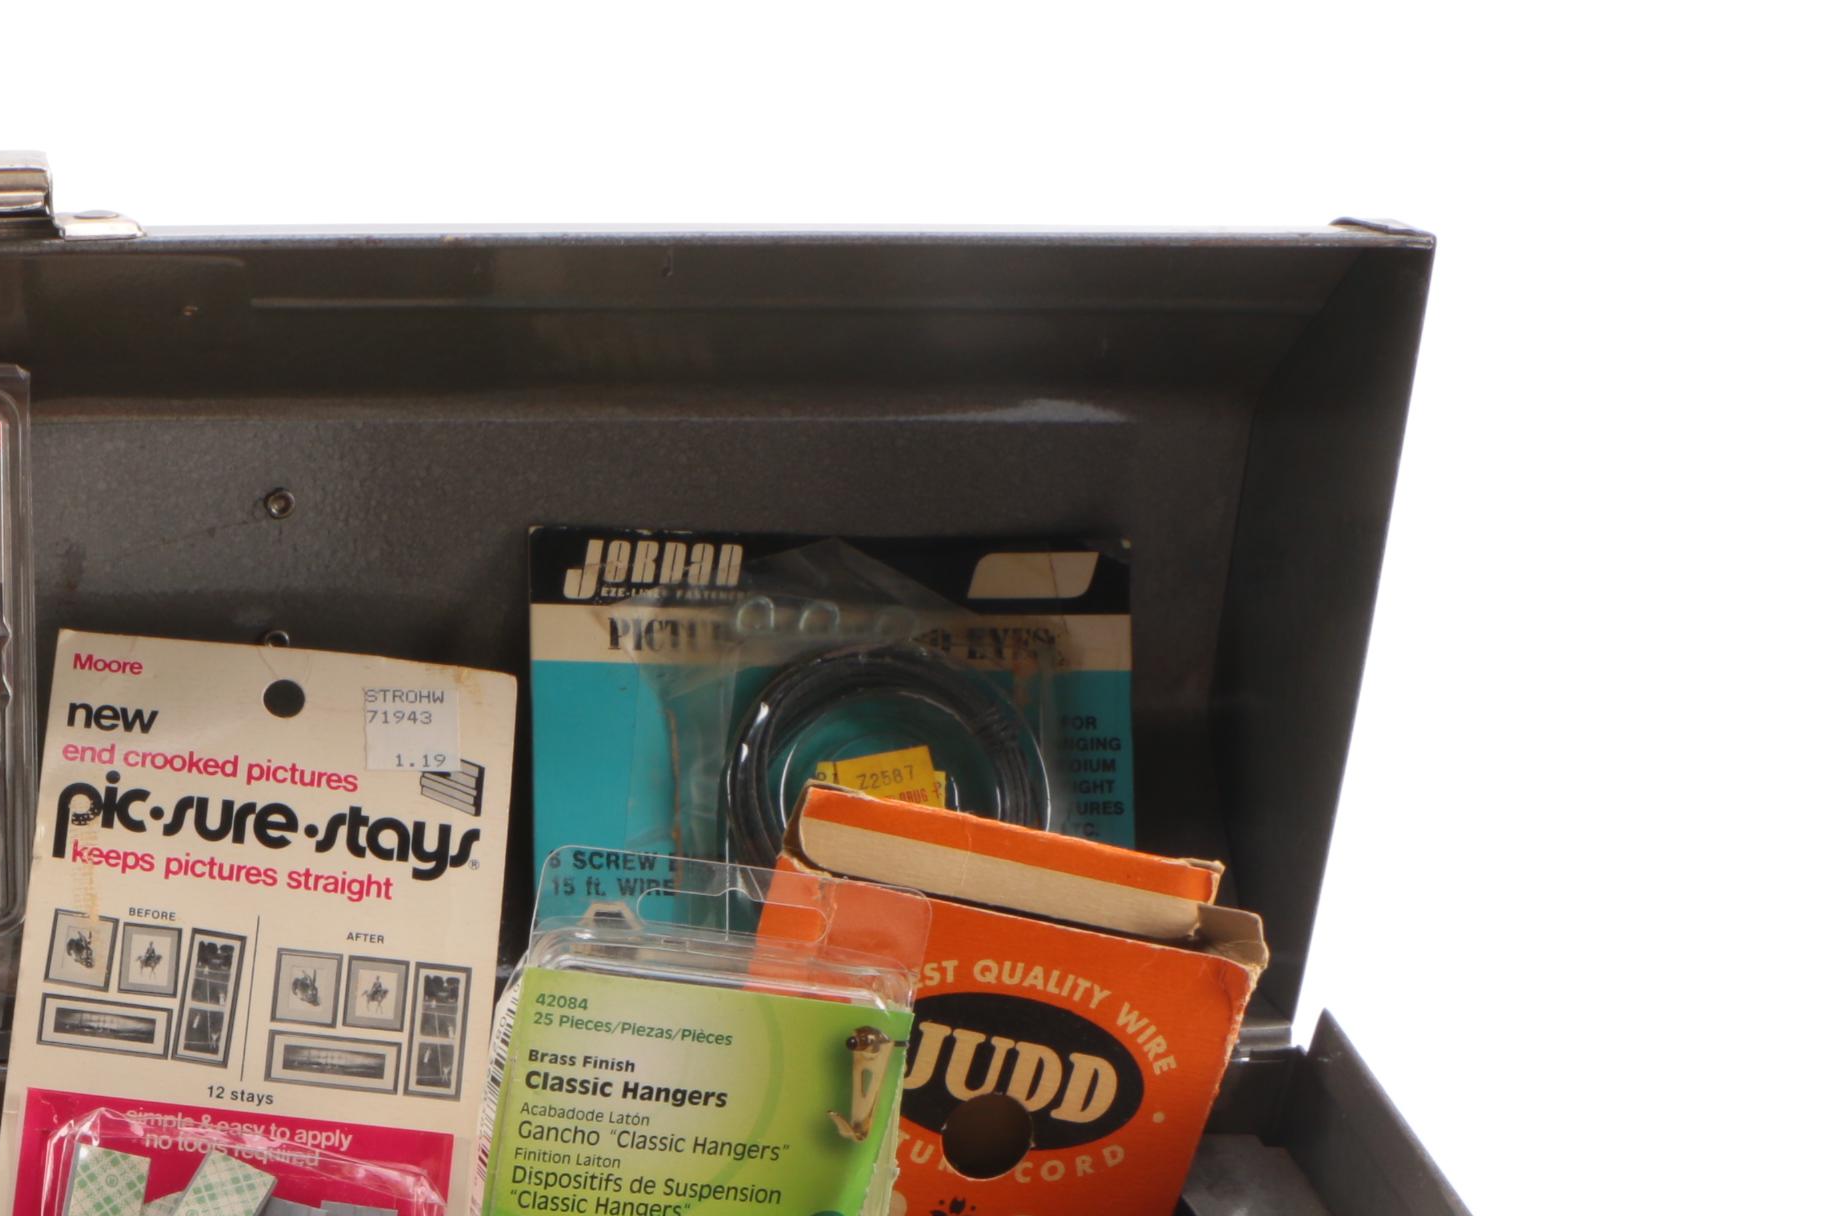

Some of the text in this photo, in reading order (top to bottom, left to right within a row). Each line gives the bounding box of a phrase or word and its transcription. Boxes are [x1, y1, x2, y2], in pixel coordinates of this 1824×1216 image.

[73, 653, 143, 675] Moore
[365, 688, 445, 705] STROHW
[67, 701, 159, 734] new
[366, 709, 433, 726] 71943
[62, 743, 358, 793] end crooked pictures
[395, 753, 447, 769] 1.19
[71, 839, 393, 901] keeps pictures straight
[573, 850, 657, 871] SCREW
[552, 877, 575, 896] 15
[617, 877, 675, 896] WIRE
[129, 907, 176, 921] BEFORE
[346, 931, 385, 945] AFTER
[536, 993, 589, 1010] 42084
[534, 1012, 554, 1026] 25
[974, 959, 1111, 1010] QUALITY
[1116, 1003, 1177, 1075] WIRE
[529, 1049, 636, 1073] Brass Finish
[904, 1021, 1117, 1123] JUDD
[207, 1085, 274, 1106] 12 stays
[525, 1071, 728, 1108] Classic Hangers
[126, 1108, 352, 1151] simple & easy to apply
[609, 1112, 650, 1126] Latón
[144, 1132, 170, 1150] no
[518, 1121, 600, 1145] Gancho
[514, 1148, 621, 1168] Finition Laiton
[1015, 1145, 1125, 1183] CORD
[512, 1166, 782, 1204] Dispositifs de Suspension
